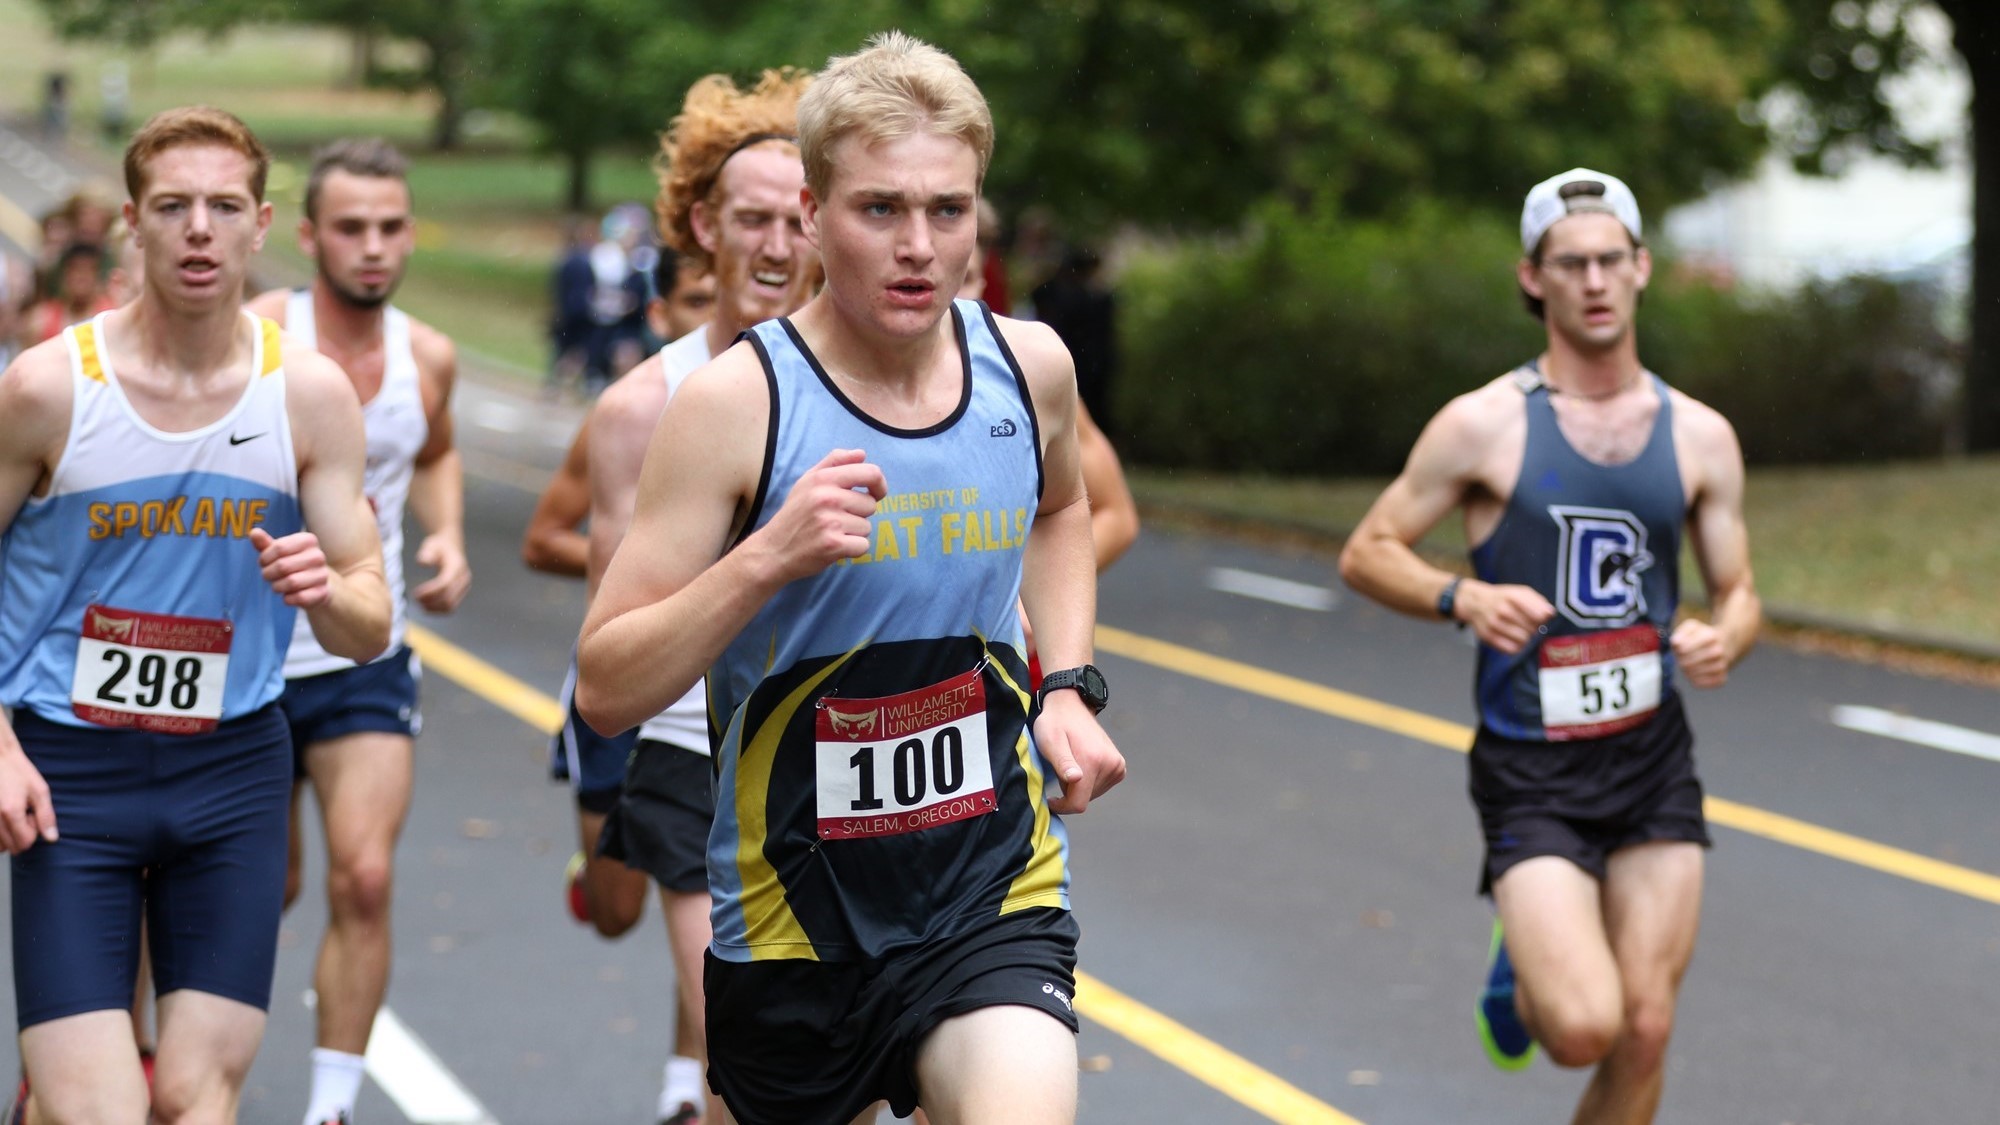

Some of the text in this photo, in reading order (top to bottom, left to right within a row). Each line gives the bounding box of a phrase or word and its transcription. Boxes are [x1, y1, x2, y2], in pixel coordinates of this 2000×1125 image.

[991, 425, 1010, 437] PCS
[88, 495, 268, 541] SPOKANE
[875, 487, 980, 515] NIVERSITY OF
[941, 507, 1028, 555] FALLS
[96, 648, 203, 710] 298
[1580, 666, 1630, 715] 53
[888, 682, 976, 720] WILLAMETTE
[888, 700, 968, 735] UNIVERSITY
[850, 726, 964, 811] 100
[843, 798, 975, 835] SALEM, OREGON
